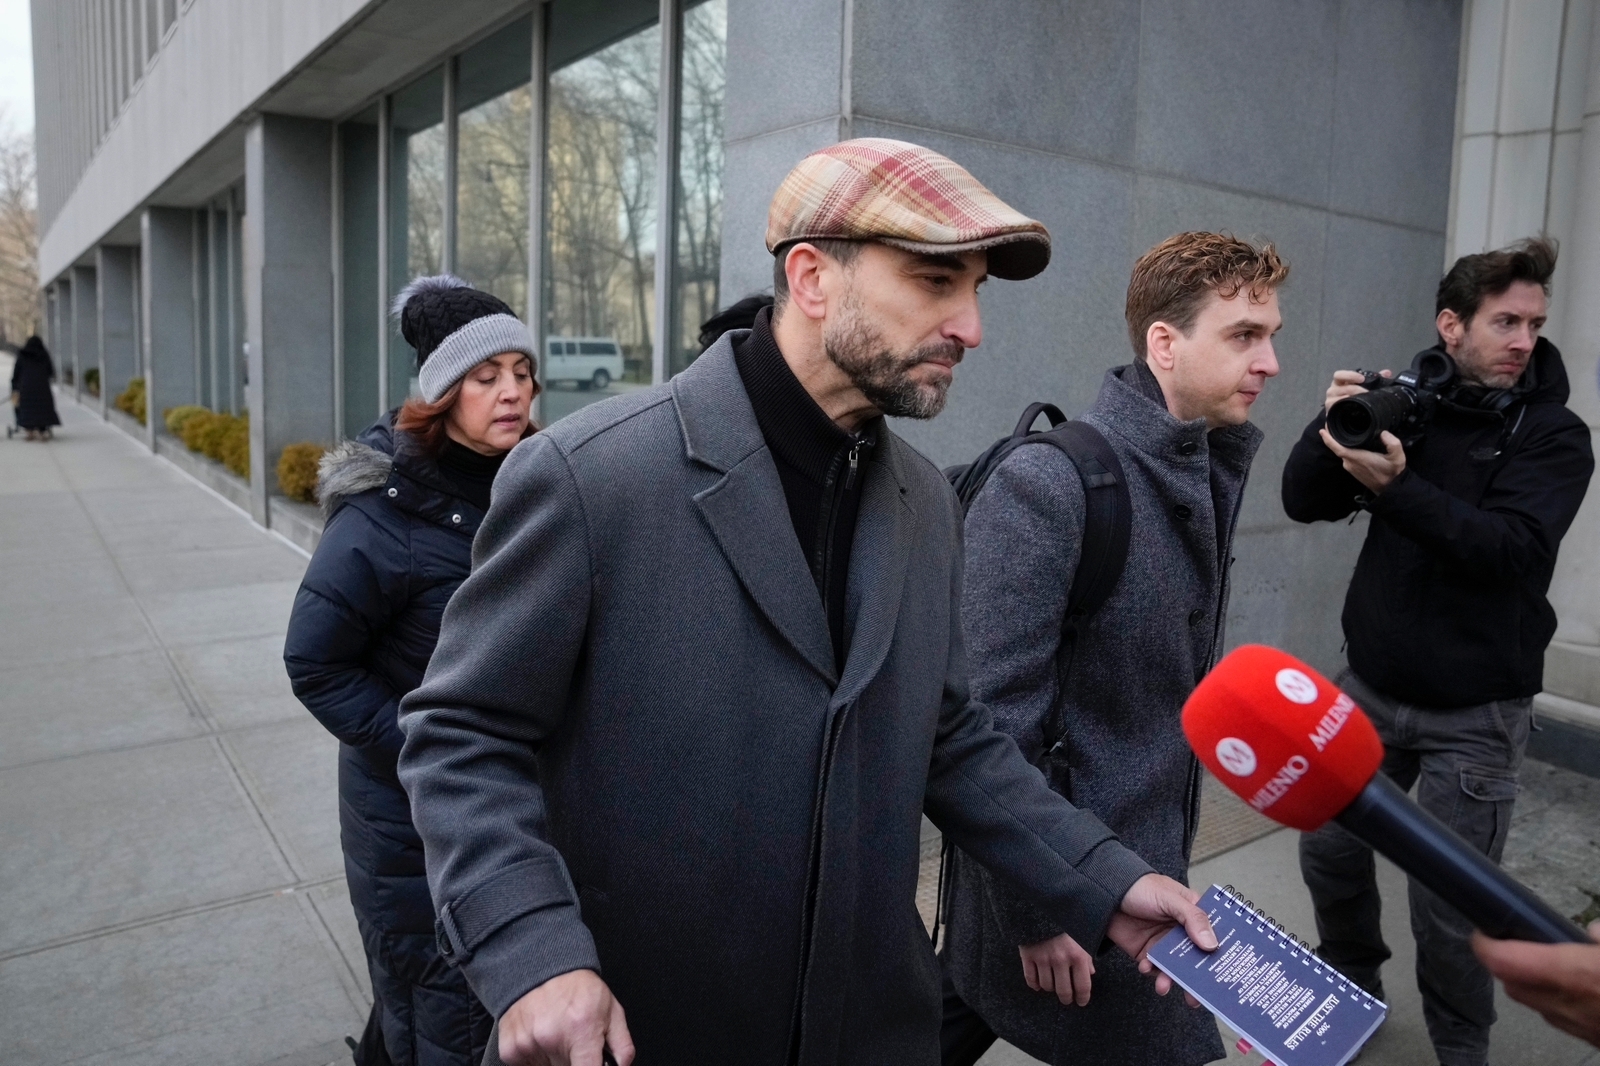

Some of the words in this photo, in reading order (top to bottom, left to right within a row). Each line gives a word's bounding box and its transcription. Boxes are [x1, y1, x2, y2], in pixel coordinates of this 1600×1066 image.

[1231, 944, 1254, 967] SENTENCING
[1237, 956, 1257, 975] SELECTED
[1239, 965, 1258, 984] EVIDENCE
[1251, 960, 1269, 978] FEDERAL
[1222, 973, 1232, 983] AND
[1241, 976, 1254, 989] RULES
[1263, 969, 1281, 986] FEDERAL
[1236, 986, 1243, 994] OF
[1252, 984, 1265, 997] RULES
[1268, 980, 1289, 1001] ADMIRALTY
[1285, 986, 1303, 1004] FEDERAL
[1286, 983, 1298, 995] CIVIL
[1294, 988, 1314, 1008] CRIMINAL
[1255, 993, 1269, 1006] RULES
[1260, 999, 1270, 1009] AND
[1266, 993, 1289, 1015] PROCEDURE
[1275, 1001, 1288, 1014] RULES
[1297, 994, 1315, 1012] FEDERAL
[1320, 995, 1340, 1015] JUST
[1270, 1012, 1277, 1020] OF
[1274, 1005, 1297, 1028] PROCEDURE
[1286, 1010, 1300, 1023] RULES
[1306, 1010, 1325, 1029] THE
[1285, 1024, 1311, 1051] RULES
[1314, 1020, 1331, 1037] 2009
